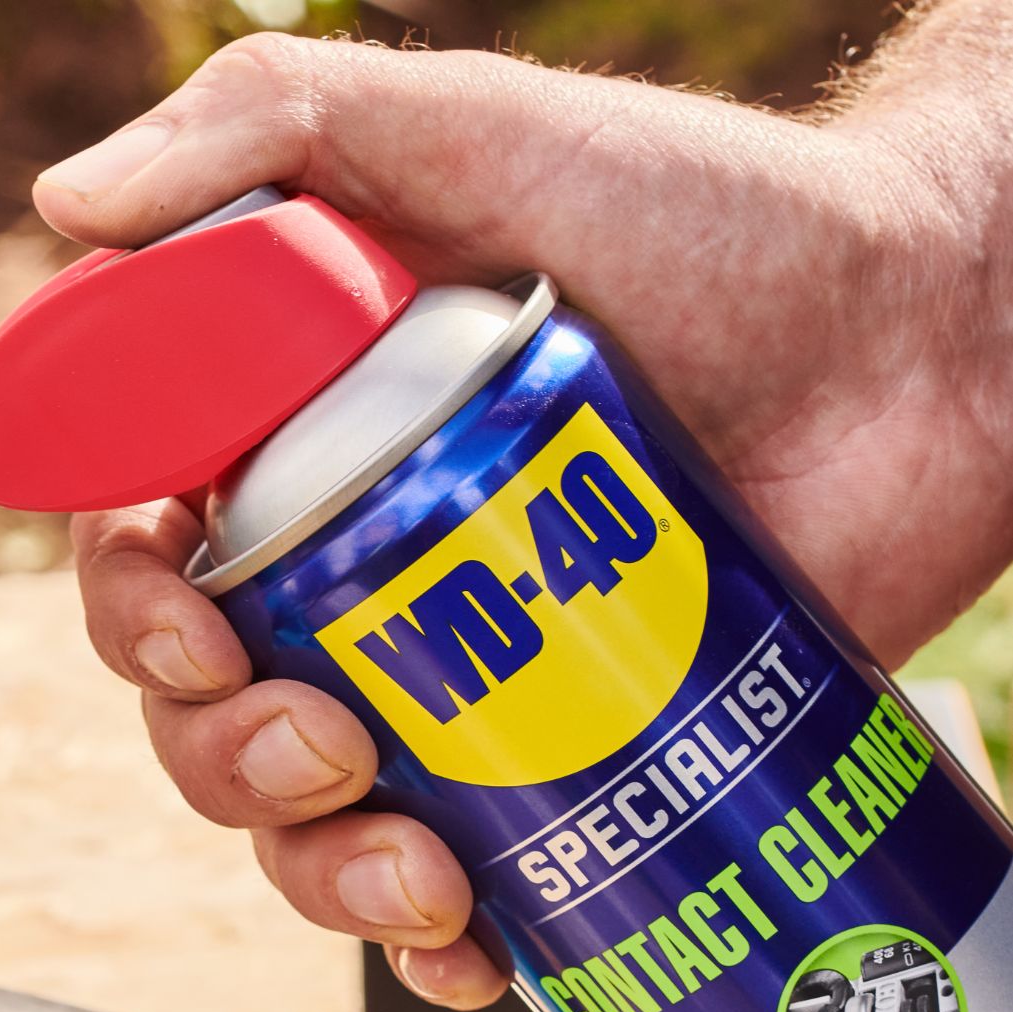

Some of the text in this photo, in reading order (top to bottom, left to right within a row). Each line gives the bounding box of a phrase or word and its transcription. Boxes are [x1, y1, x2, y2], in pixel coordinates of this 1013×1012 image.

[353, 450, 657, 725] WD-40
[517, 643, 806, 902] SPECIALIST
[757, 692, 935, 904] CLEANER
